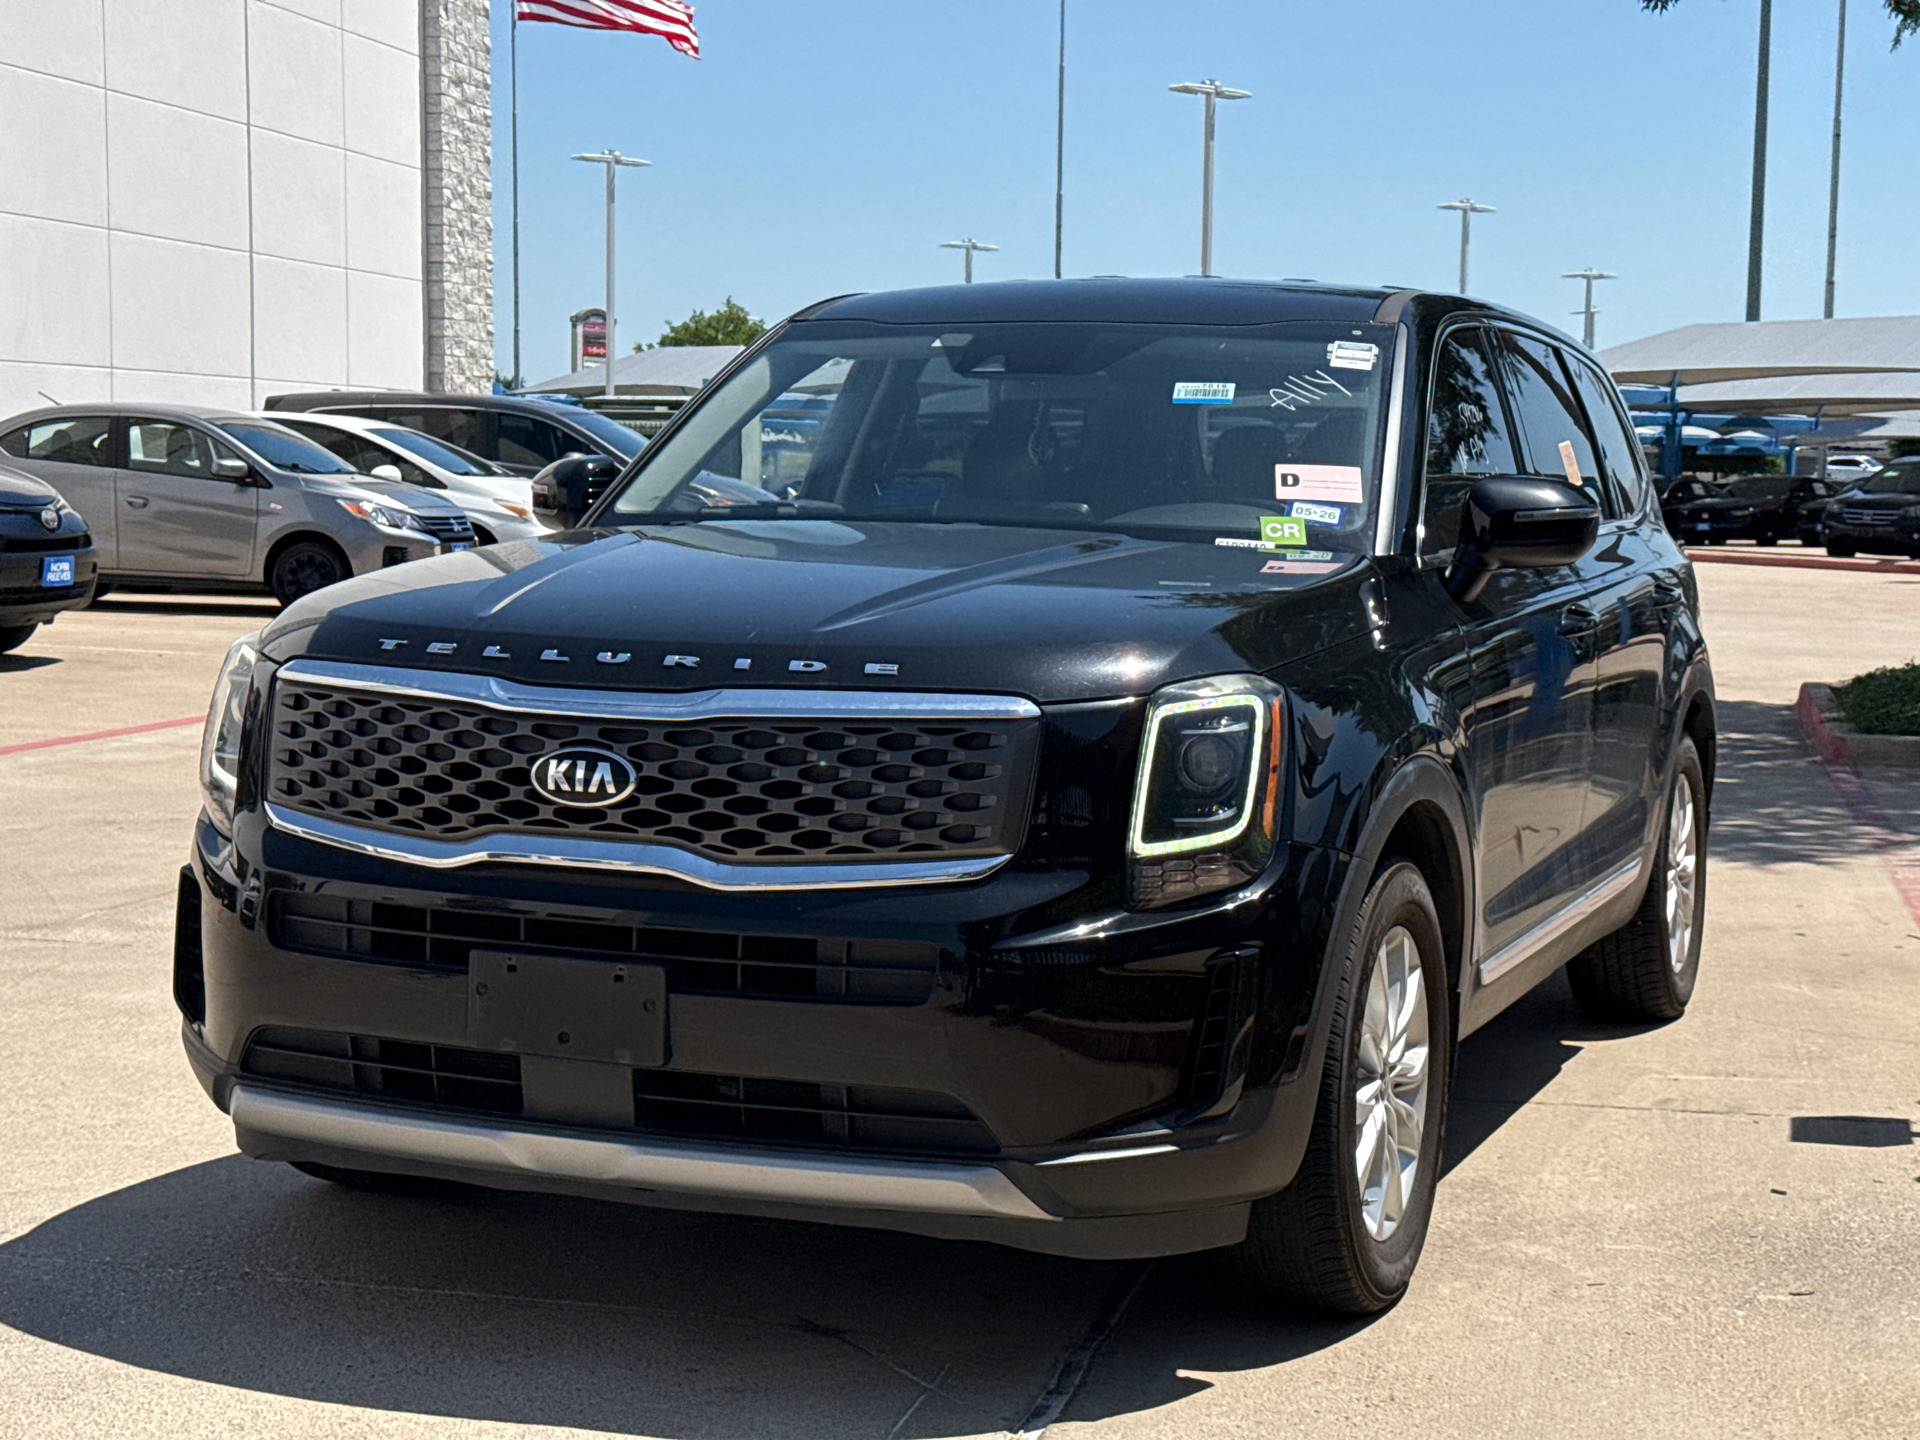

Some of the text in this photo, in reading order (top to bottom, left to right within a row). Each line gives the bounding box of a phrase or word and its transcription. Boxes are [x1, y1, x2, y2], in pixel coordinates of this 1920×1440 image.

[1280, 473, 1300, 487] D
[1265, 522, 1300, 538] CR
[378, 638, 900, 676] TELLURIDE
[546, 758, 617, 794] KIA
